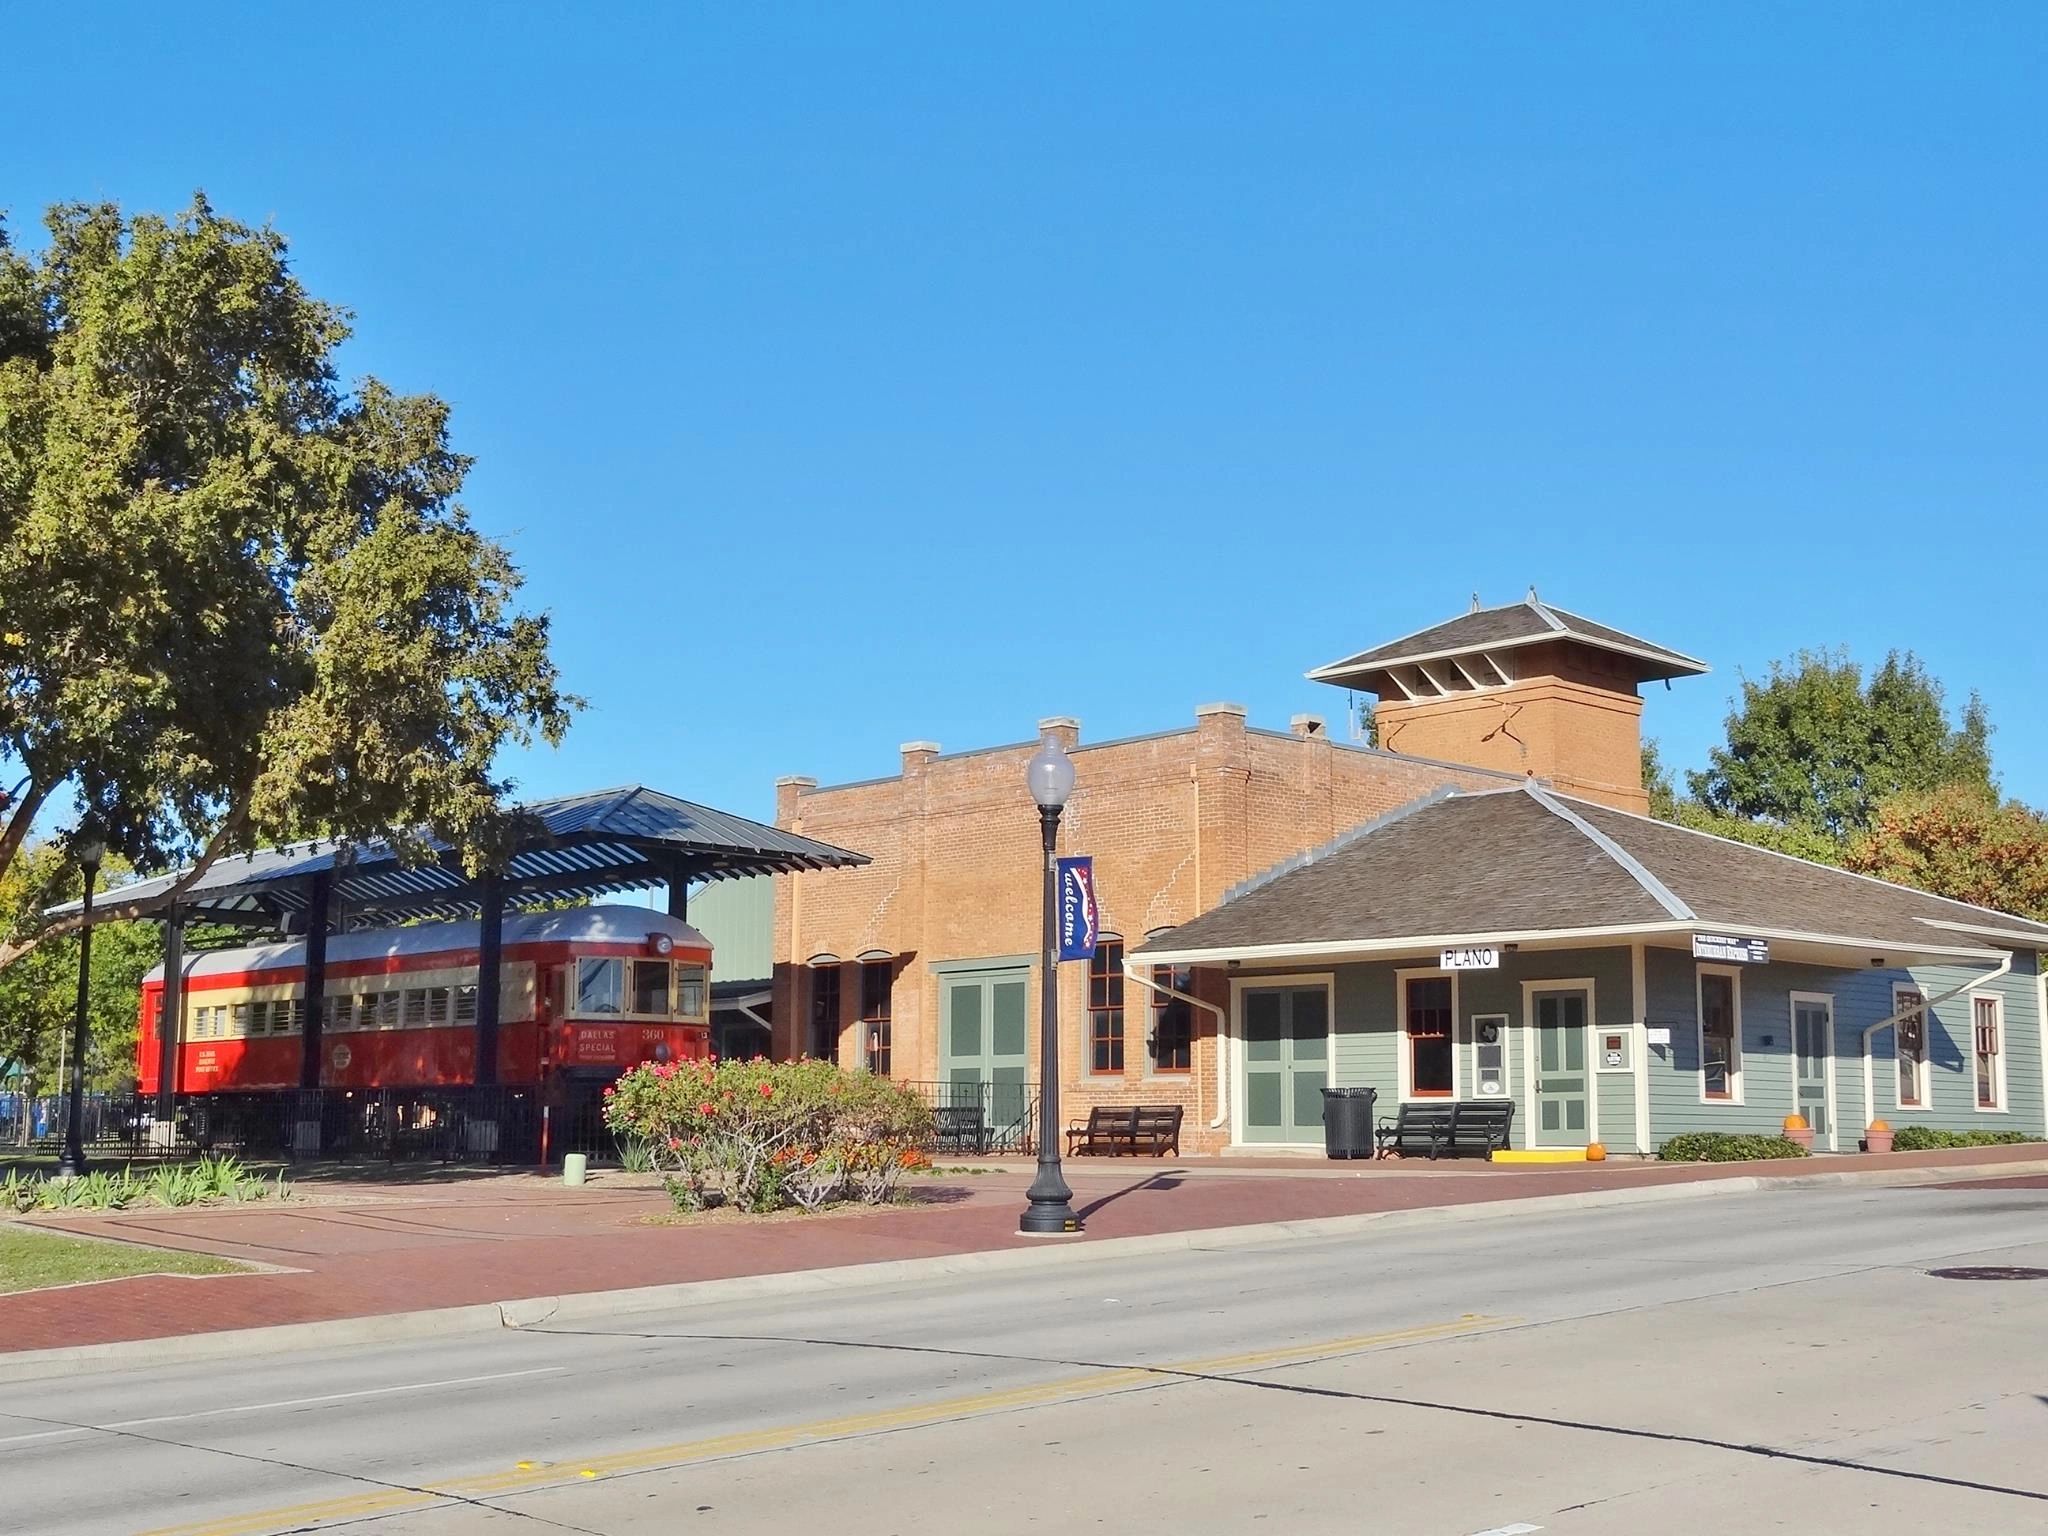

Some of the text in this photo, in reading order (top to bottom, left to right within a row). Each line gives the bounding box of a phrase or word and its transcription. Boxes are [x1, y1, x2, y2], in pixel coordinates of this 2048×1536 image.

[1064, 872, 1078, 947] welcome
[1445, 949, 1492, 966] PLANO
[580, 1030, 615, 1039] DALLAS
[642, 1029, 664, 1040] 360
[579, 1043, 616, 1052] SPECIAL
